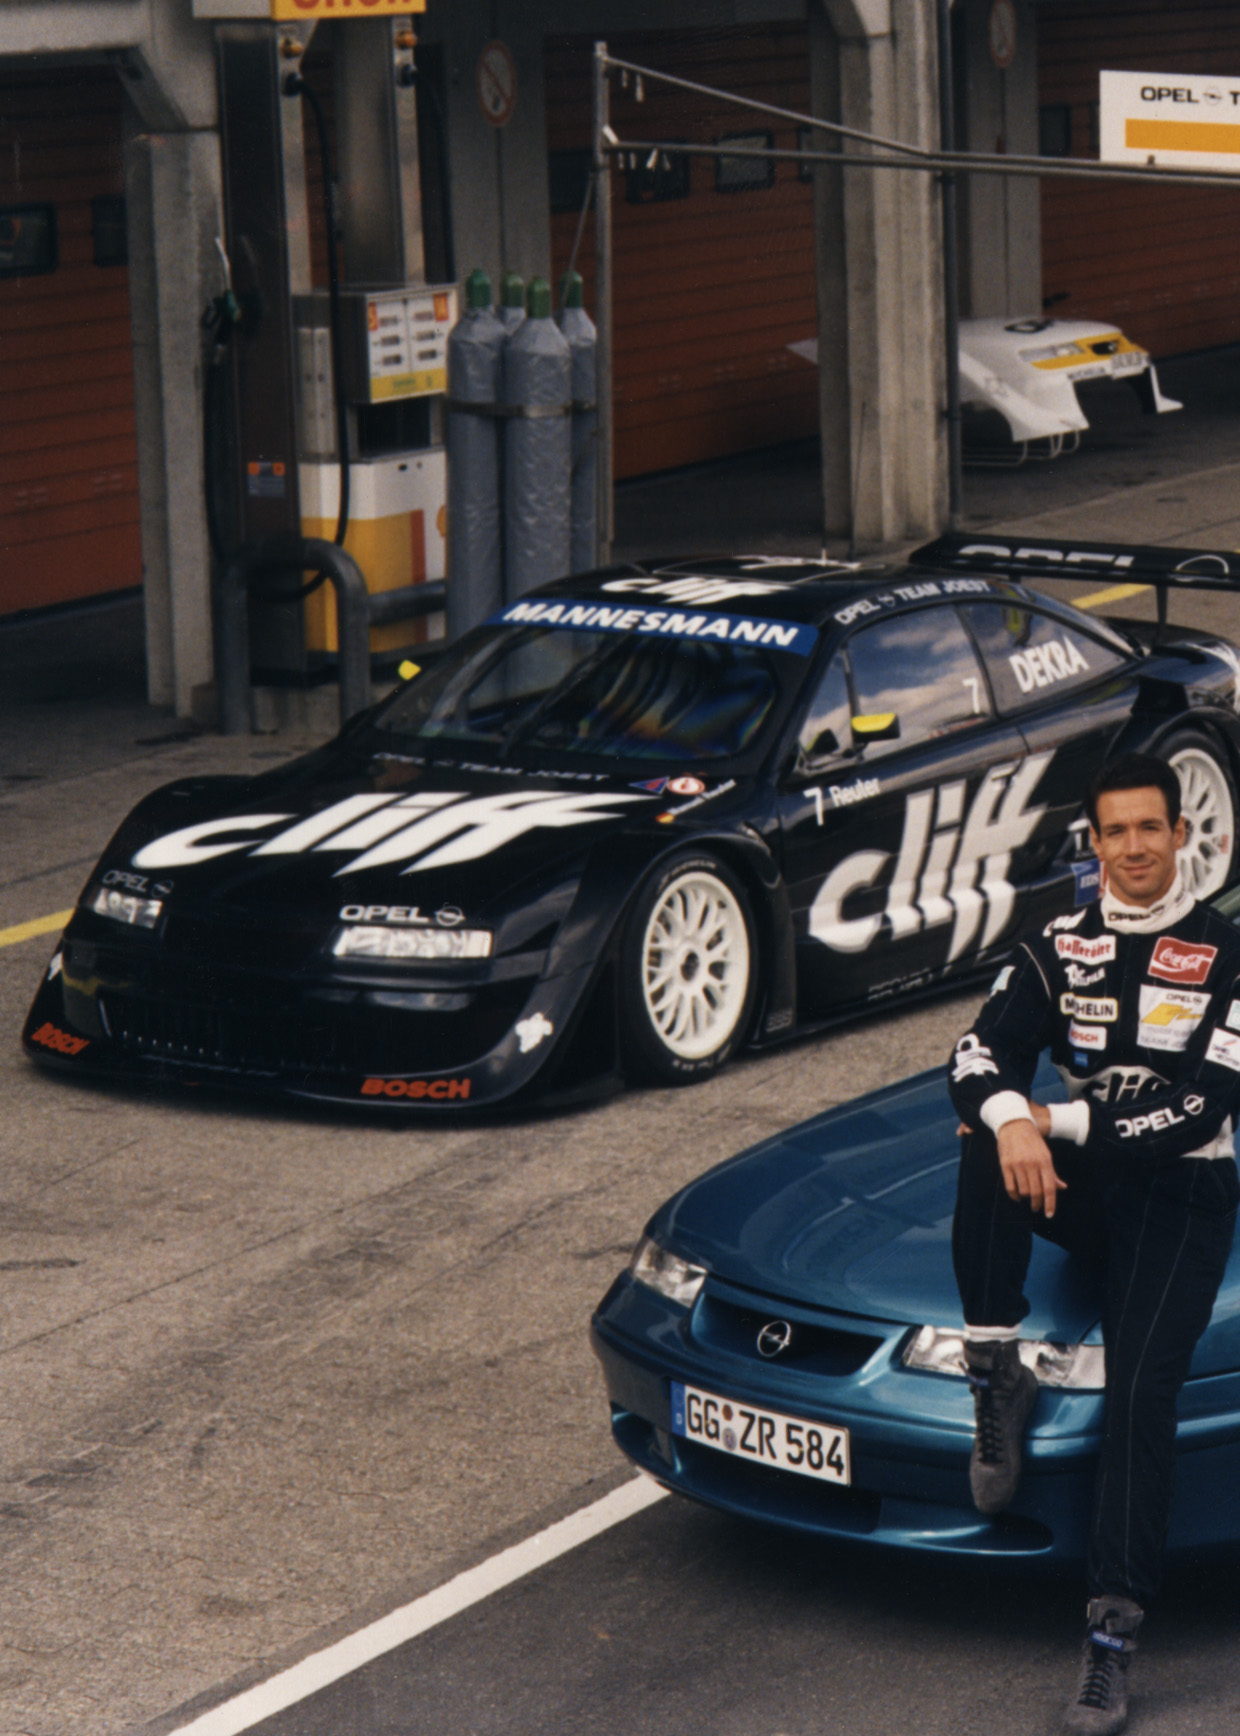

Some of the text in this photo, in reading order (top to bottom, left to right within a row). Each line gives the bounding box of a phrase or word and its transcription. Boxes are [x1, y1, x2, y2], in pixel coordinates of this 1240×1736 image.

[1140, 86, 1199, 103] OPEL
[834, 579, 991, 625] OPEL TEAM JOEST
[503, 603, 798, 646] MANNESMANN
[1008, 634, 1090, 693] DEKRA
[963, 677, 980, 714] 7
[459, 761, 523, 775] TEAM
[803, 778, 881, 826] 7 Reuter
[132, 790, 662, 878] cliff
[808, 750, 1056, 964] cliff
[102, 869, 149, 892] OPEL
[339, 904, 430, 923] OPEL
[1065, 999, 1113, 1016] MHELIN
[31, 1022, 90, 1055] BOSCH
[361, 1077, 471, 1099] BOSCH
[1115, 1107, 1185, 1138] OPEL
[687, 1393, 844, 1476] GG ZR 584
